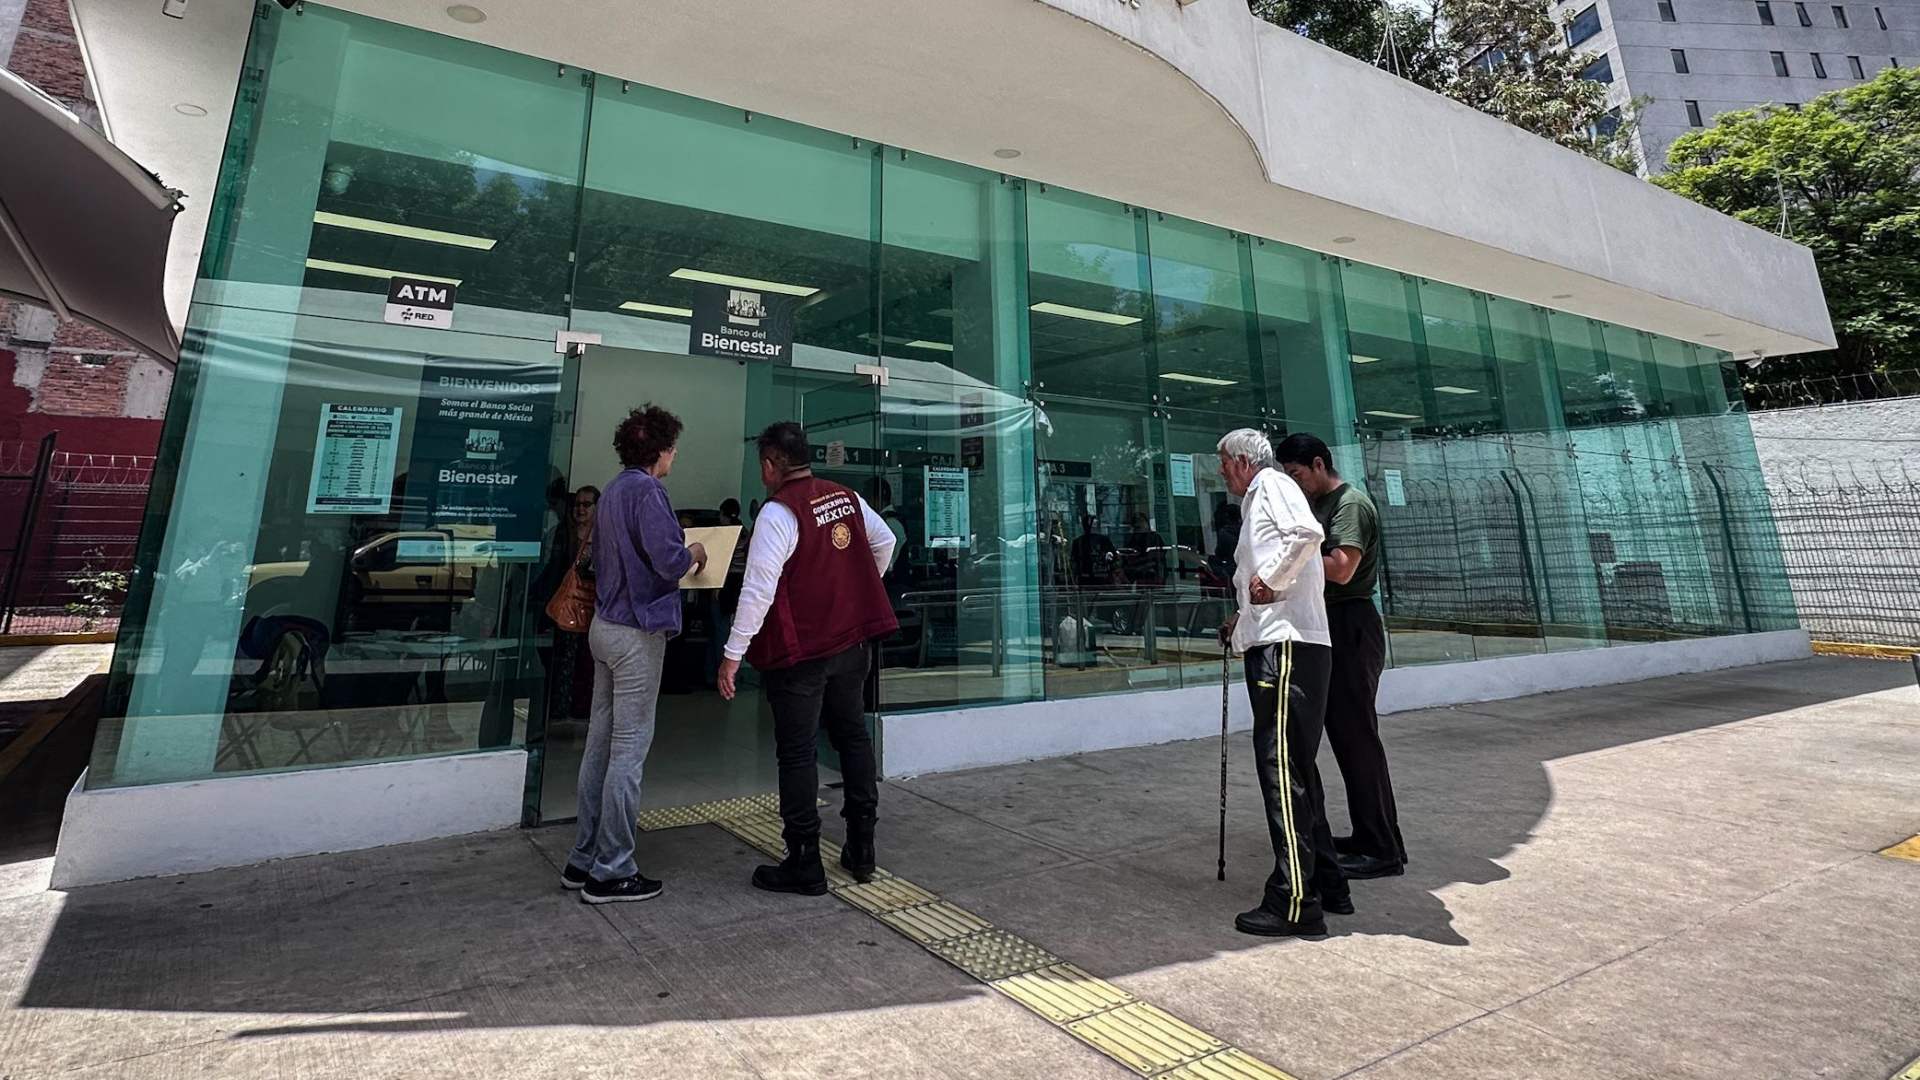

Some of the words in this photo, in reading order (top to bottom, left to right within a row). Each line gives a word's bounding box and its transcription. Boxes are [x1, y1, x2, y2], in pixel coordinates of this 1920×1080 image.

[397, 284, 447, 303] ATM
[414, 312, 434, 320] RED
[720, 325, 750, 337] Banco
[751, 330, 766, 339] del
[701, 332, 782, 356] Bienestar
[439, 376, 540, 394] BIENVENIDOS
[337, 405, 388, 413] CALENDARIO
[440, 398, 469, 408] Somos
[470, 399, 479, 408] el
[480, 401, 507, 410] Banco
[508, 403, 534, 412] Social
[438, 408, 457, 417] más
[458, 410, 489, 420] grande
[491, 411, 501, 420] de
[503, 411, 534, 422] México
[438, 469, 518, 485] Bienestar
[812, 497, 844, 515] GOBIERNO
[815, 504, 856, 527] MÉXICO
